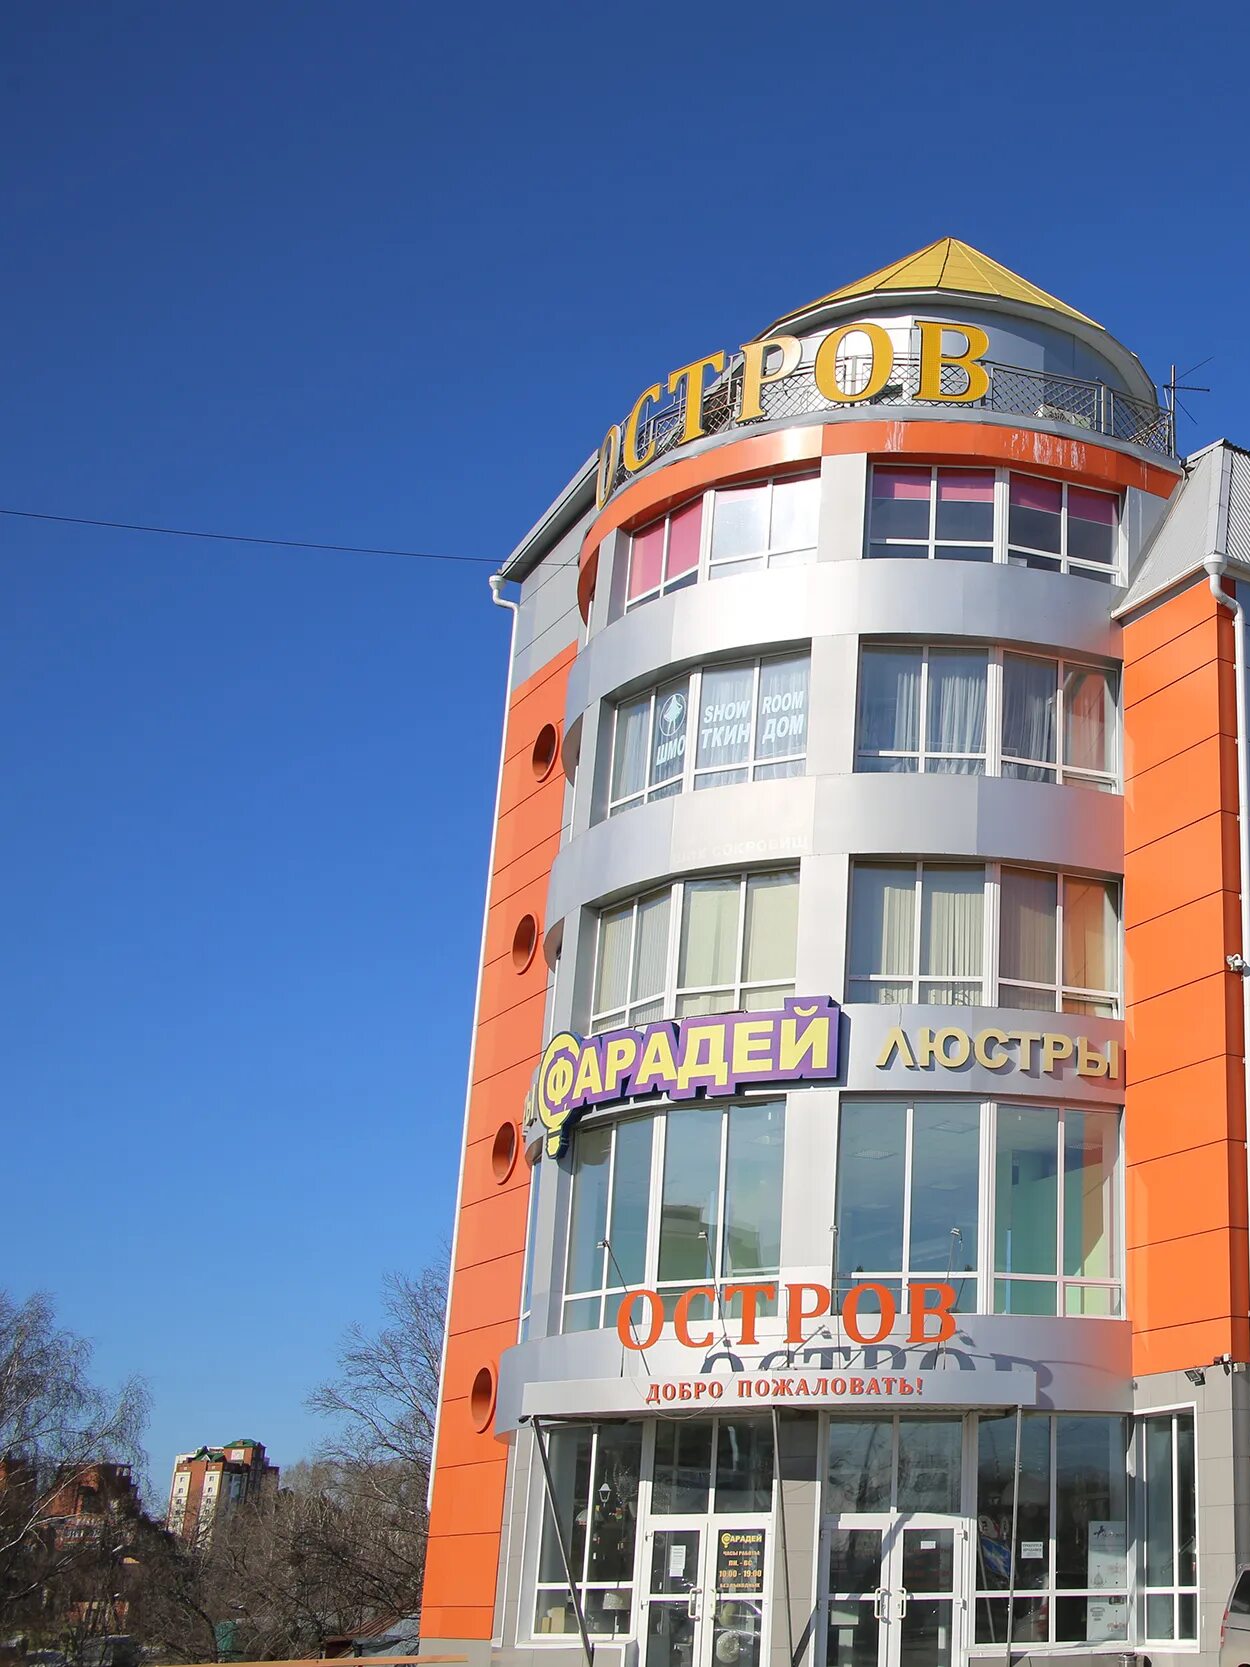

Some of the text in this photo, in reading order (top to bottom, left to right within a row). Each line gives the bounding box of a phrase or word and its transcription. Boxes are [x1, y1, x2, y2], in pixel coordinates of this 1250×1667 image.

[596, 320, 990, 511] ОСТРОВ
[704, 691, 805, 724] SHOW ROOM
[761, 714, 805, 744] ДОМ
[547, 1005, 829, 1105] ФАРАДЕЙ
[876, 1026, 1120, 1079] ЛЮСТРЫ
[617, 1282, 959, 1350] ОСТРОВ
[646, 1377, 924, 1405] ДОБРО ПОЖАЛОВАТЬ!
